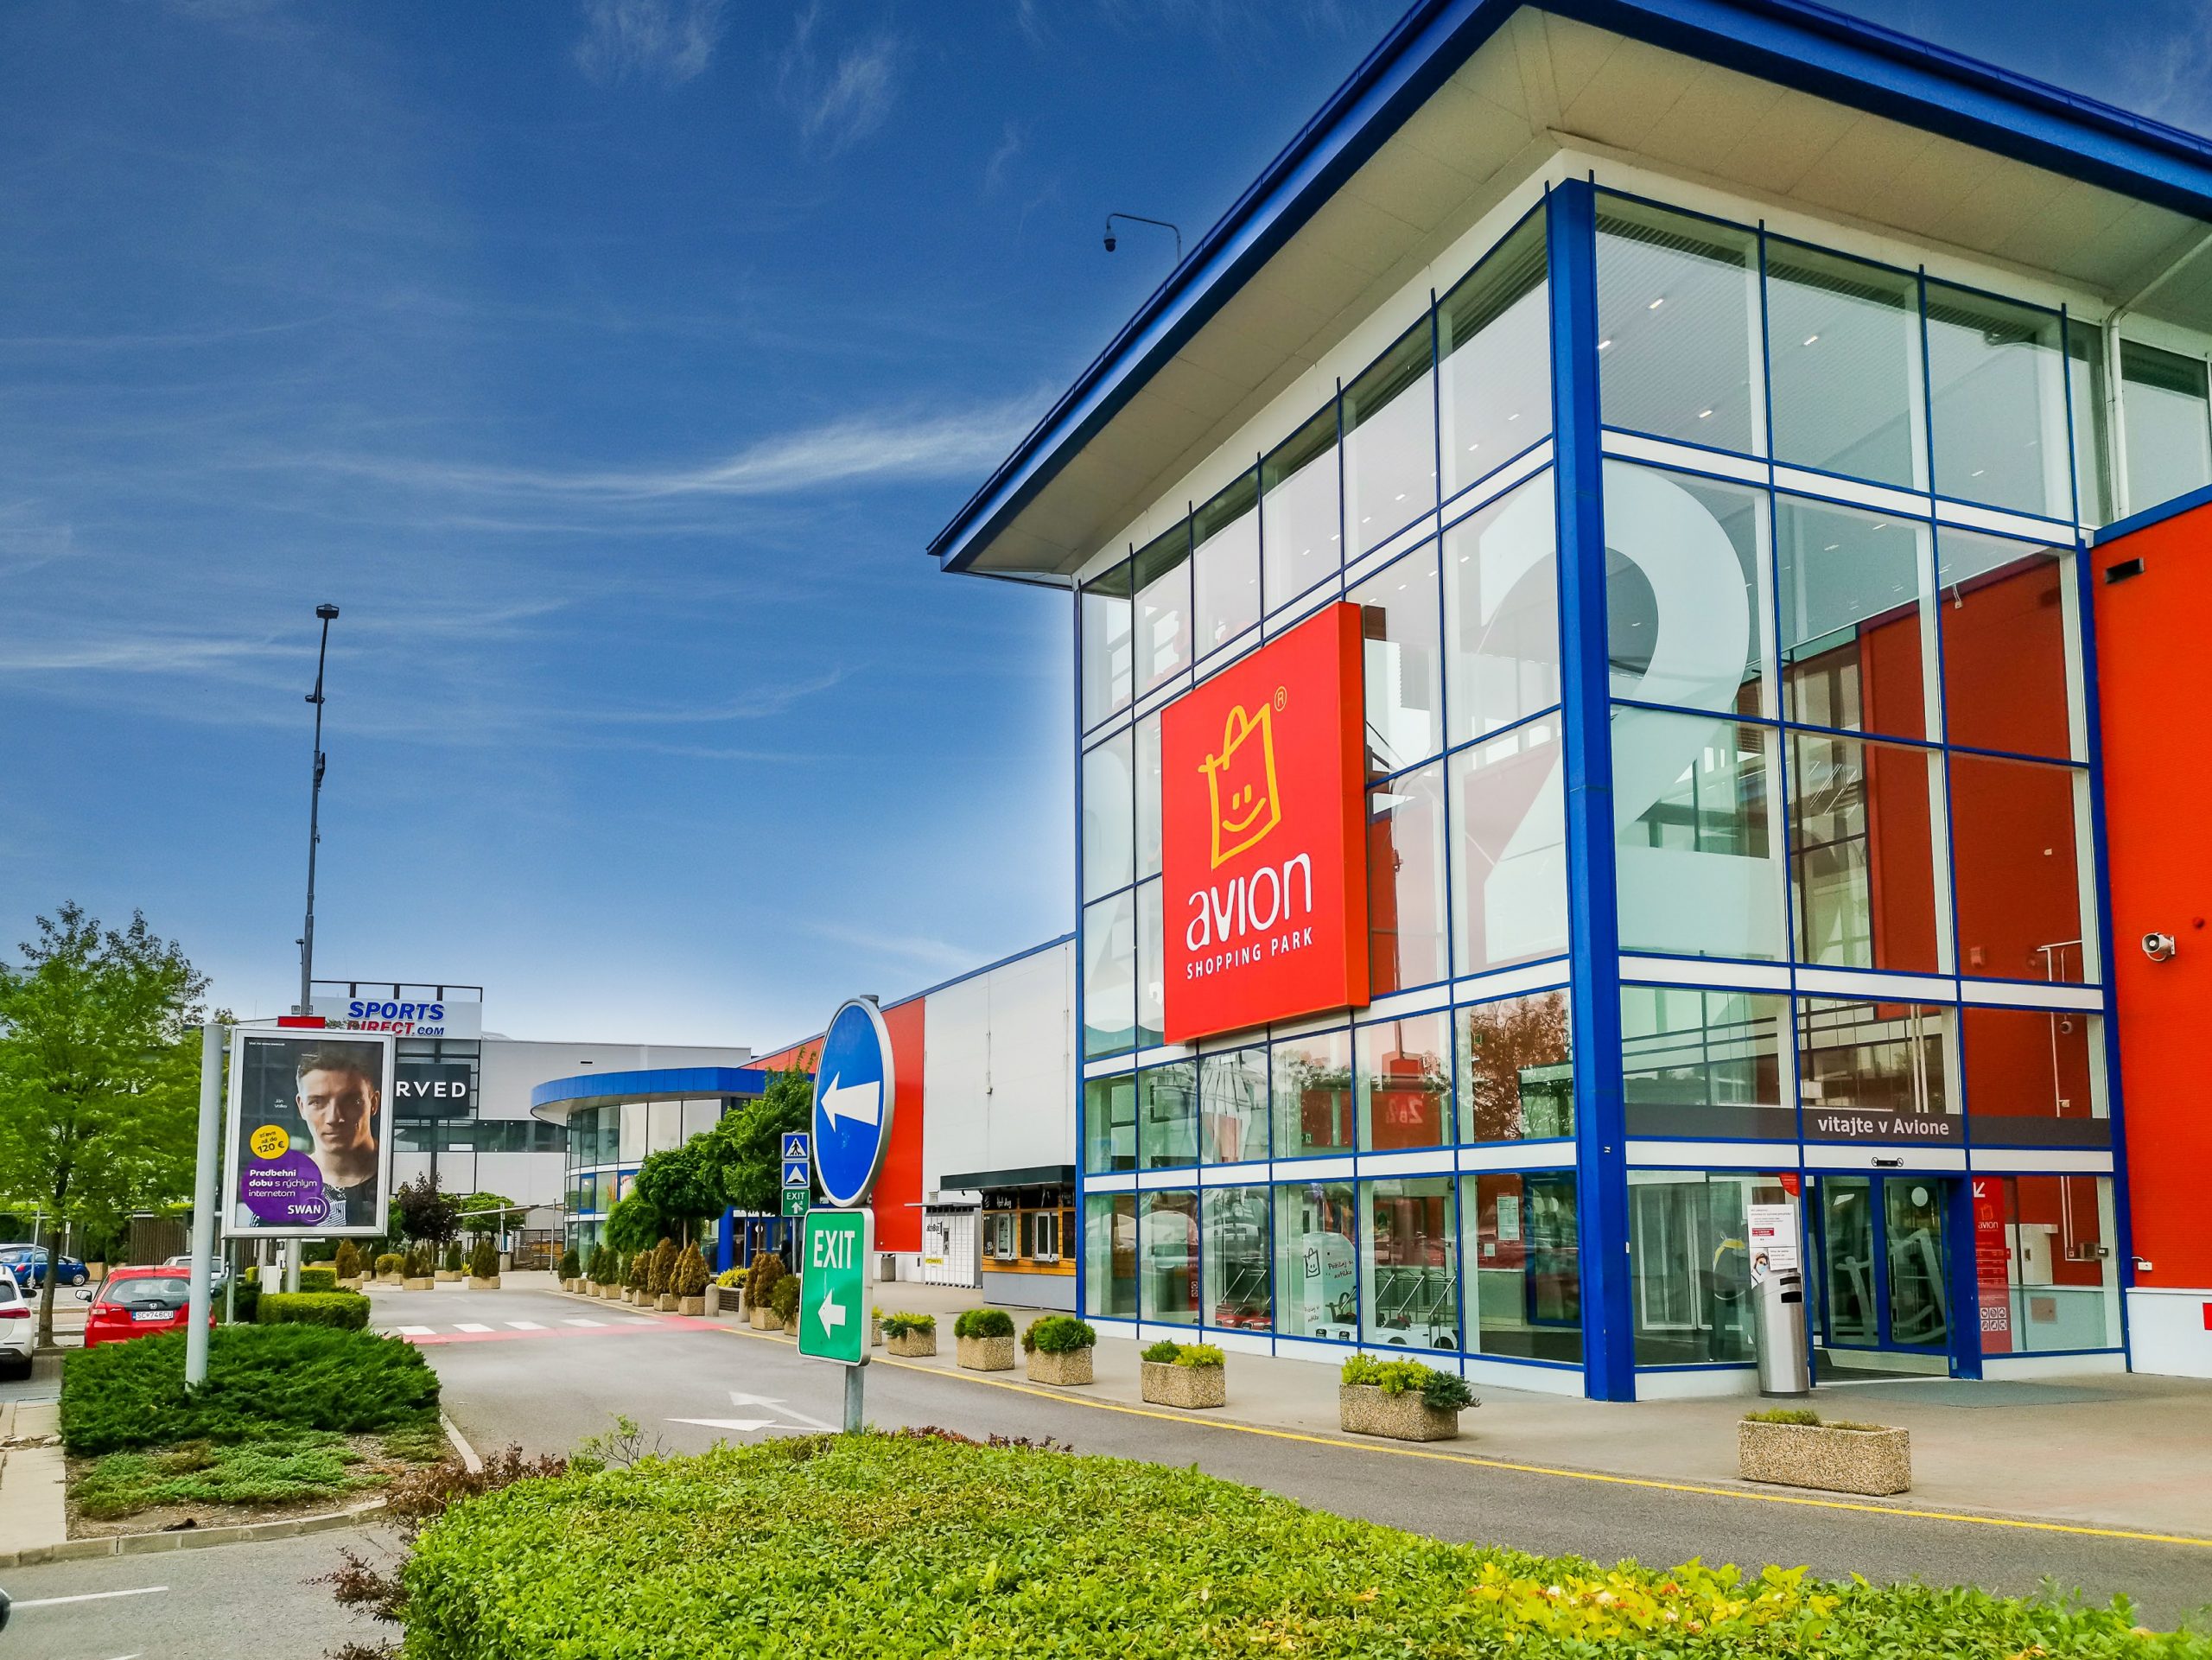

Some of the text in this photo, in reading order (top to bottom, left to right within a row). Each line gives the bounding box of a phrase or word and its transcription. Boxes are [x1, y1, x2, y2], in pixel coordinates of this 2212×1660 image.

[1186, 852, 1312, 951] avion
[1186, 926, 1313, 980] SHOPPING PARK
[348, 1001, 444, 1021] SPORTS
[396, 1081, 467, 1097] RVED
[1817, 1116, 1949, 1136] vitajte v Avione
[257, 1142, 276, 1154] 120
[282, 1179, 318, 1189] rýchlym
[786, 1192, 805, 1200] EXIT
[287, 1205, 321, 1215] SWAN
[813, 1230, 855, 1269] EXIT
